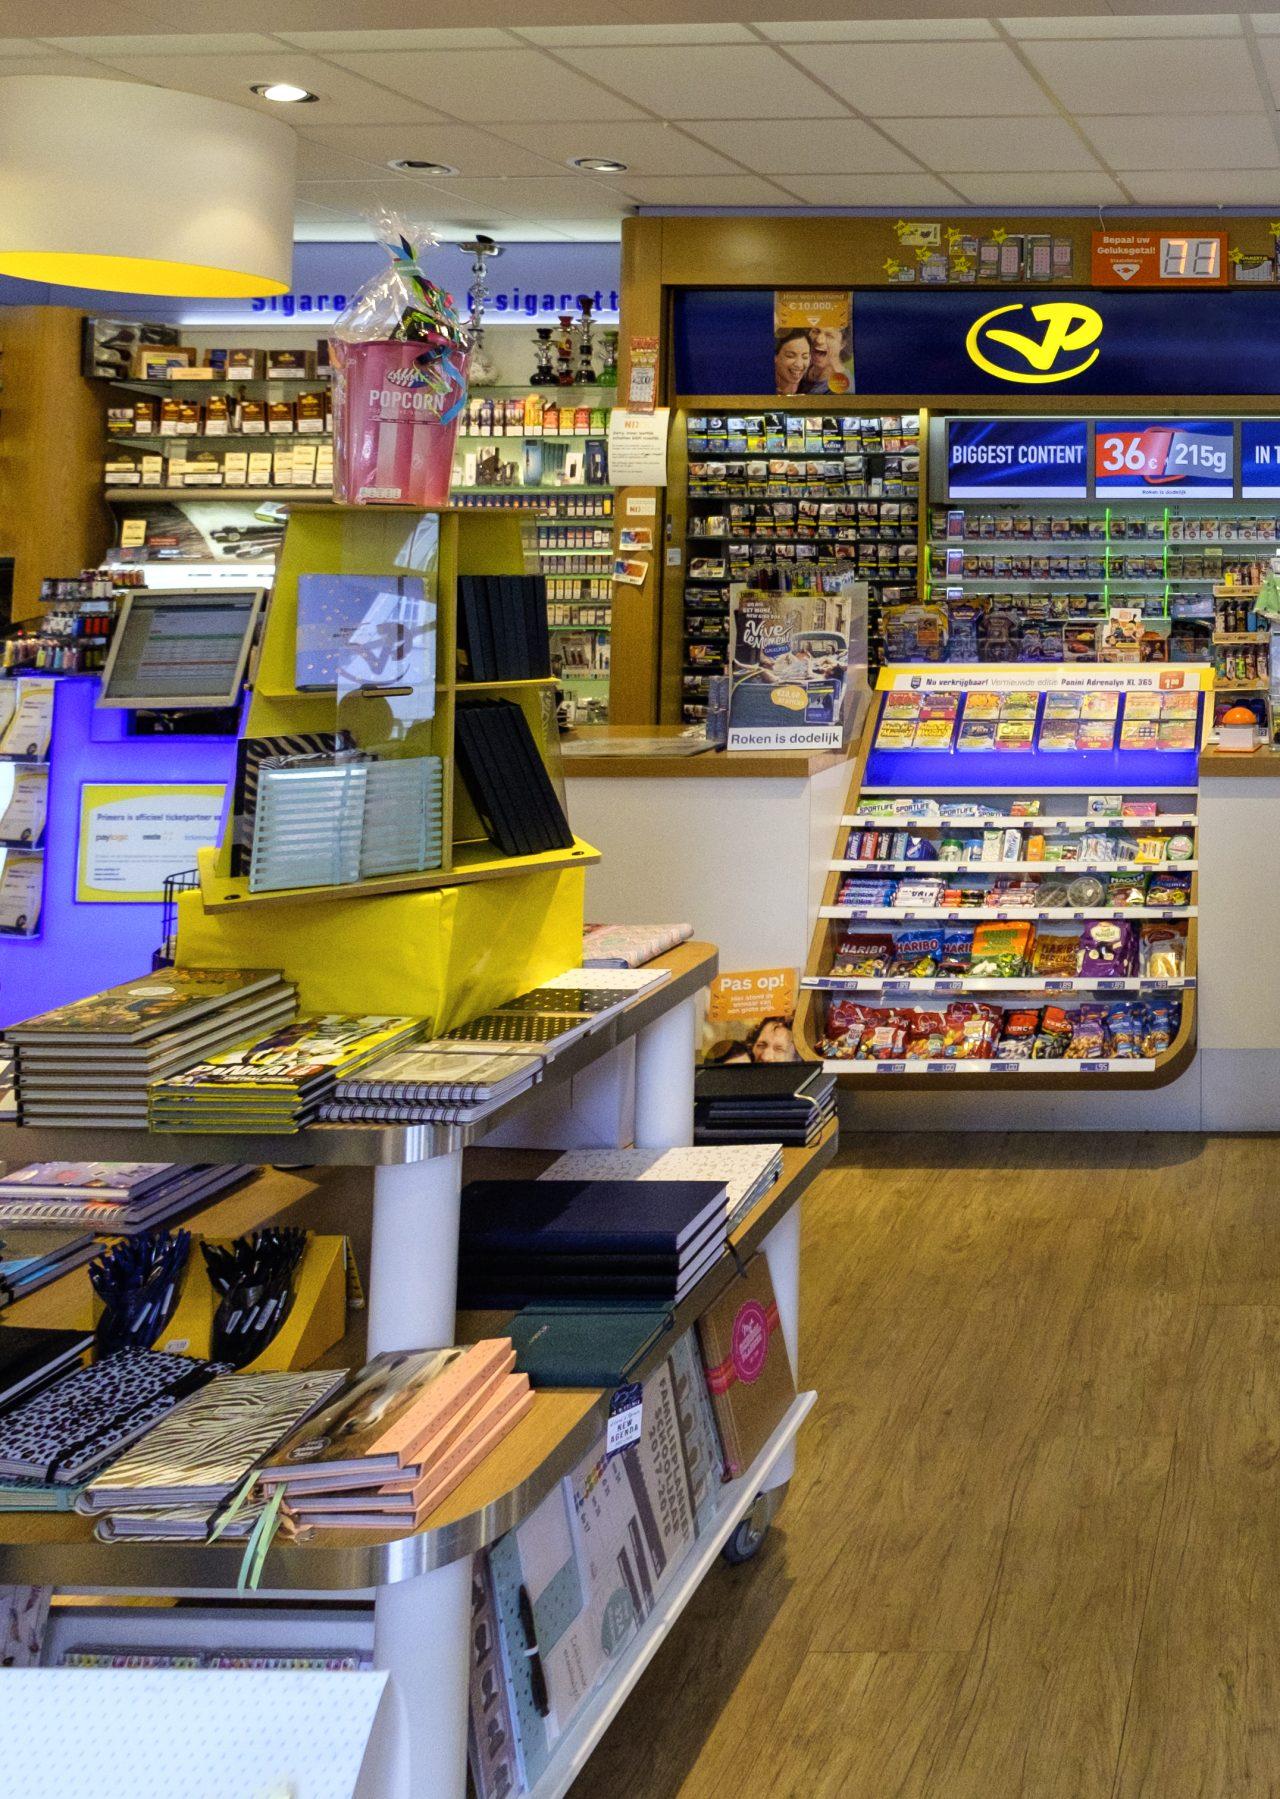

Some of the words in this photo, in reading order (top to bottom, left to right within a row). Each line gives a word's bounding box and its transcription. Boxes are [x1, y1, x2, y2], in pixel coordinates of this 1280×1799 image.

[1103, 236, 1135, 246] Bepaal
[1136, 237, 1151, 245] uw
[369, 389, 445, 411] POPCORN
[952, 445, 1014, 465] BIGGEST
[1017, 445, 1084, 465] CONTENT
[1102, 437, 1146, 471] 36
[1174, 443, 1227, 473] 215g
[1254, 445, 1270, 465] IN
[731, 734, 772, 745] Roken
[775, 733, 787, 744] is
[791, 732, 840, 745] dodelijk
[860, 803, 894, 814] SPORTLIFE
[896, 802, 930, 813] SPORTLIFE
[840, 943, 887, 954] HARIBO
[896, 939, 939, 953] HARIBO
[720, 978, 752, 992] Pas
[757, 974, 785, 991] op!
[616, 1418, 633, 1432] NEW
